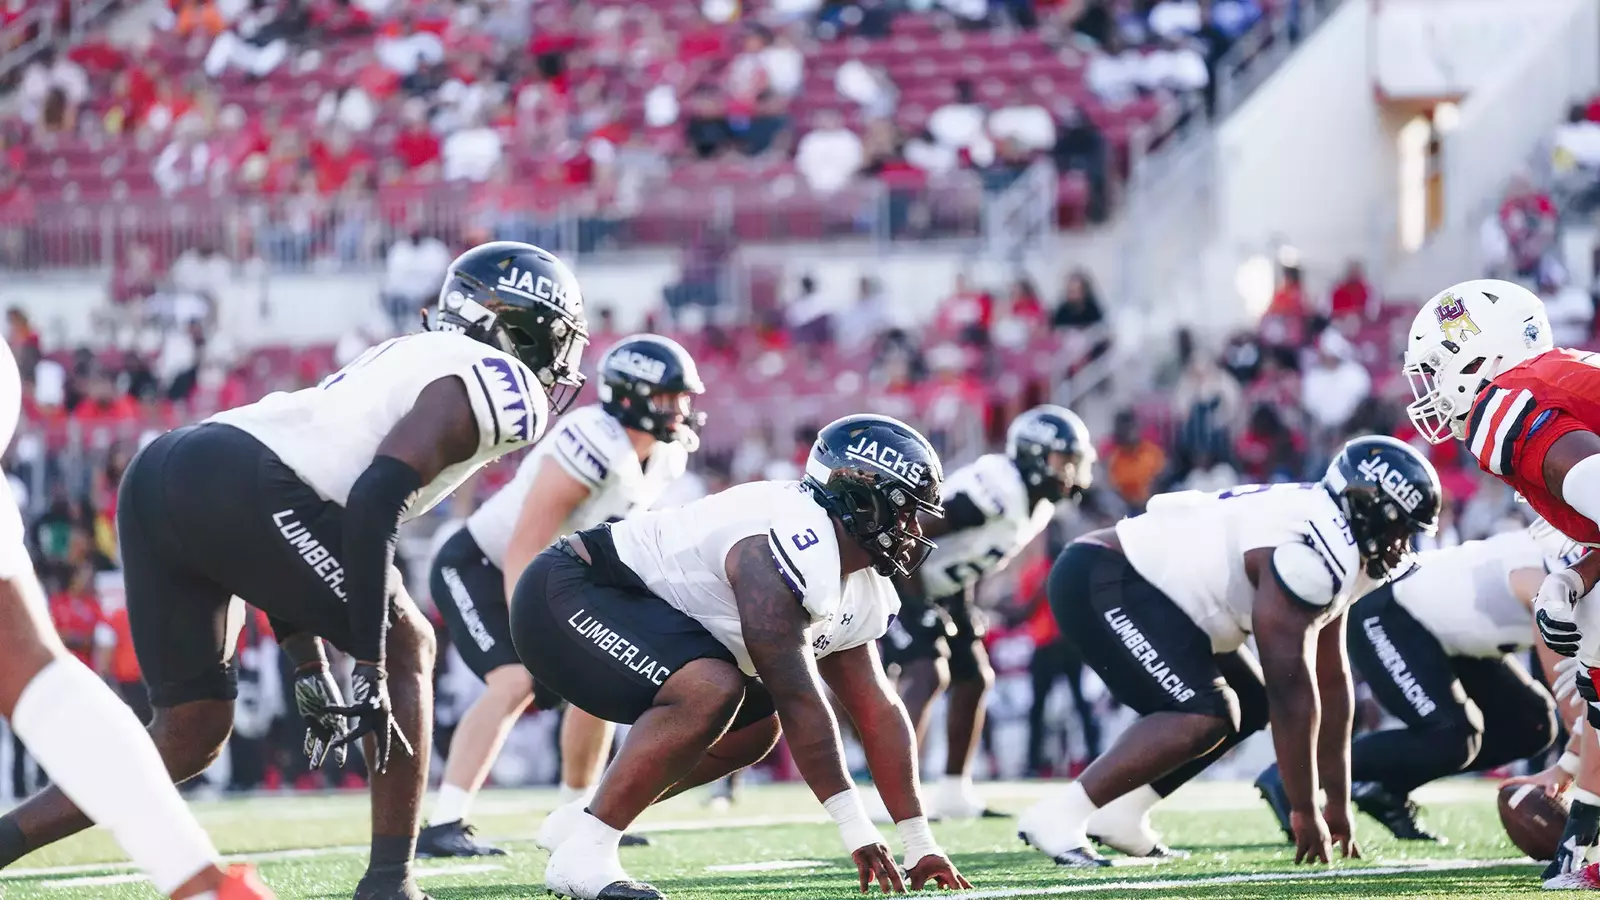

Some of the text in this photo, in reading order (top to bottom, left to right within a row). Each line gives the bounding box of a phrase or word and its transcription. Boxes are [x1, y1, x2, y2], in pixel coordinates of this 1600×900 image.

[498, 267, 571, 312] JACK
[848, 437, 925, 485] JACKS
[1360, 456, 1423, 507] JACKS
[791, 528, 819, 551] 3
[568, 609, 670, 686] LUMBERJAC
[1104, 607, 1196, 703] LUMBERJACKS
[1363, 616, 1436, 717] LUMBERJACKS
